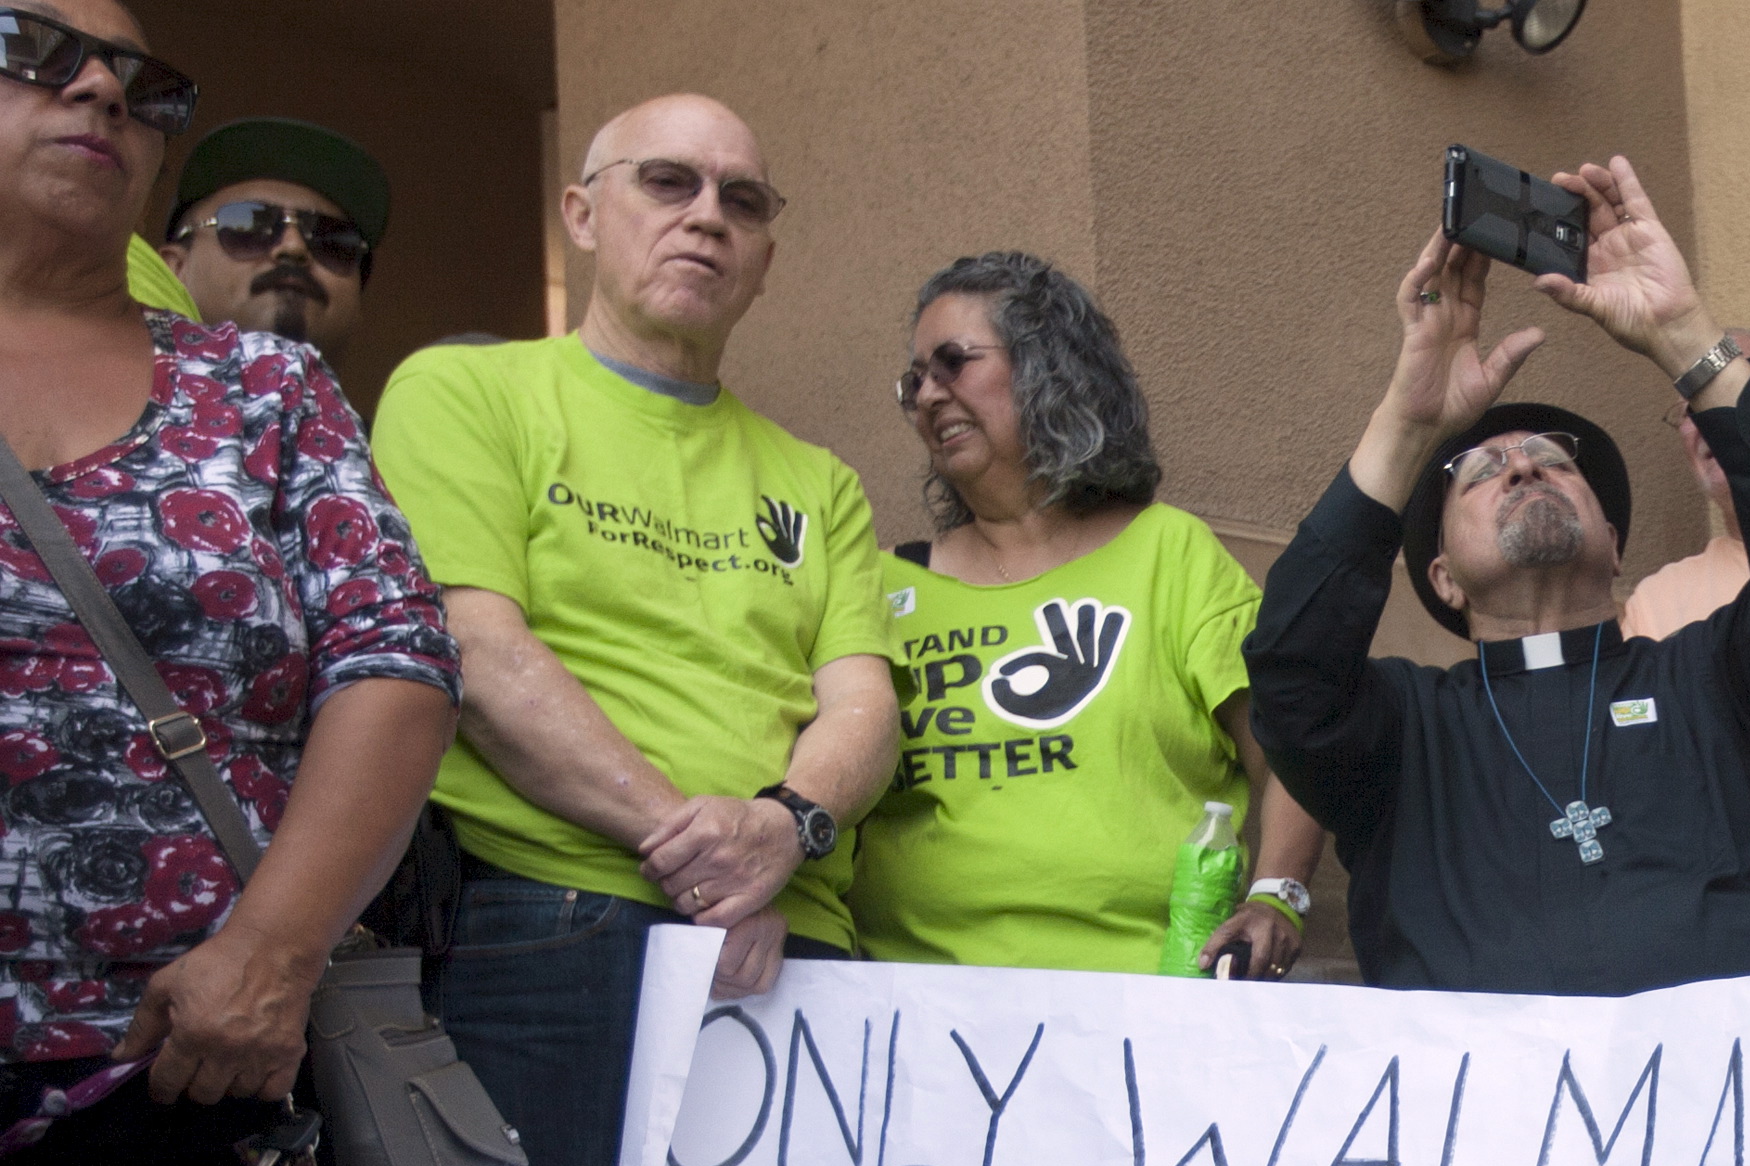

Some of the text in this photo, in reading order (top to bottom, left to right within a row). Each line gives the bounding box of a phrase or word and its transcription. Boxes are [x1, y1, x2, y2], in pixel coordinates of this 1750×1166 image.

[548, 482, 751, 549] OURWalmart
[903, 624, 1009, 661] TAND
[901, 706, 976, 740] ve
[901, 733, 1079, 790] ETTER
